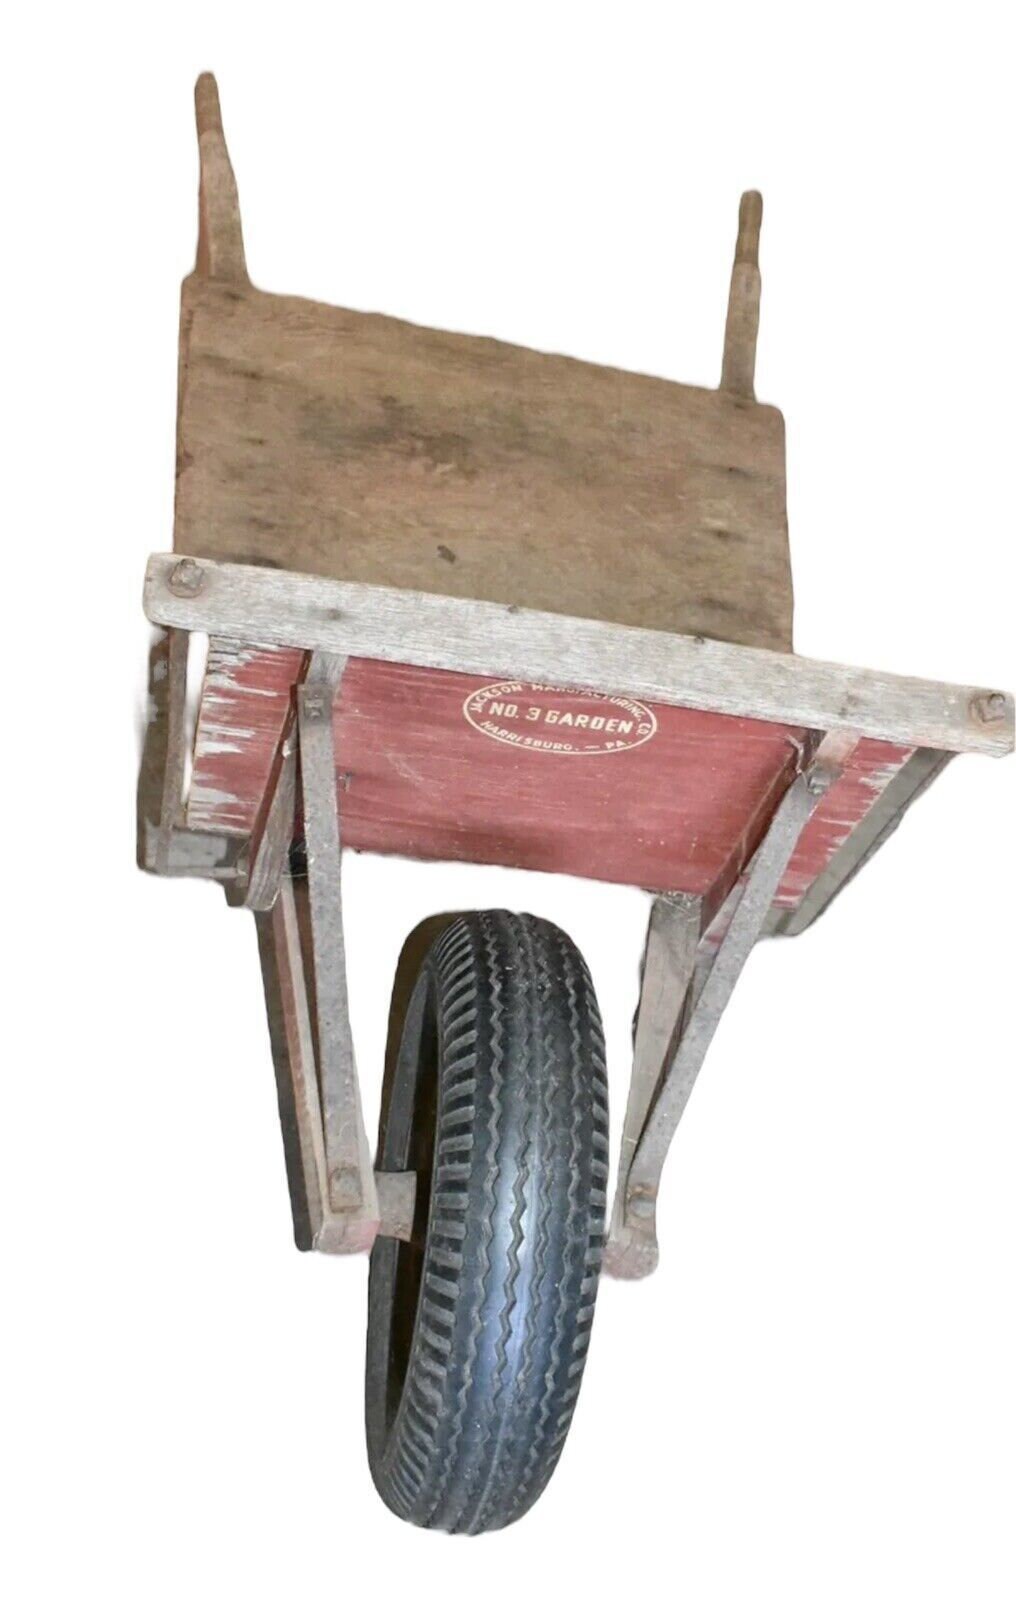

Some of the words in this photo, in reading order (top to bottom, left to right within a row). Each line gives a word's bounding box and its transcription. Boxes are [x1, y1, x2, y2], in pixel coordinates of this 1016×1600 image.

[470, 684, 523, 713] JACKSON
[488, 702, 519, 719] NO.
[525, 707, 542, 721] 3
[544, 711, 634, 734] GARDEN
[604, 740, 632, 750] PA.
